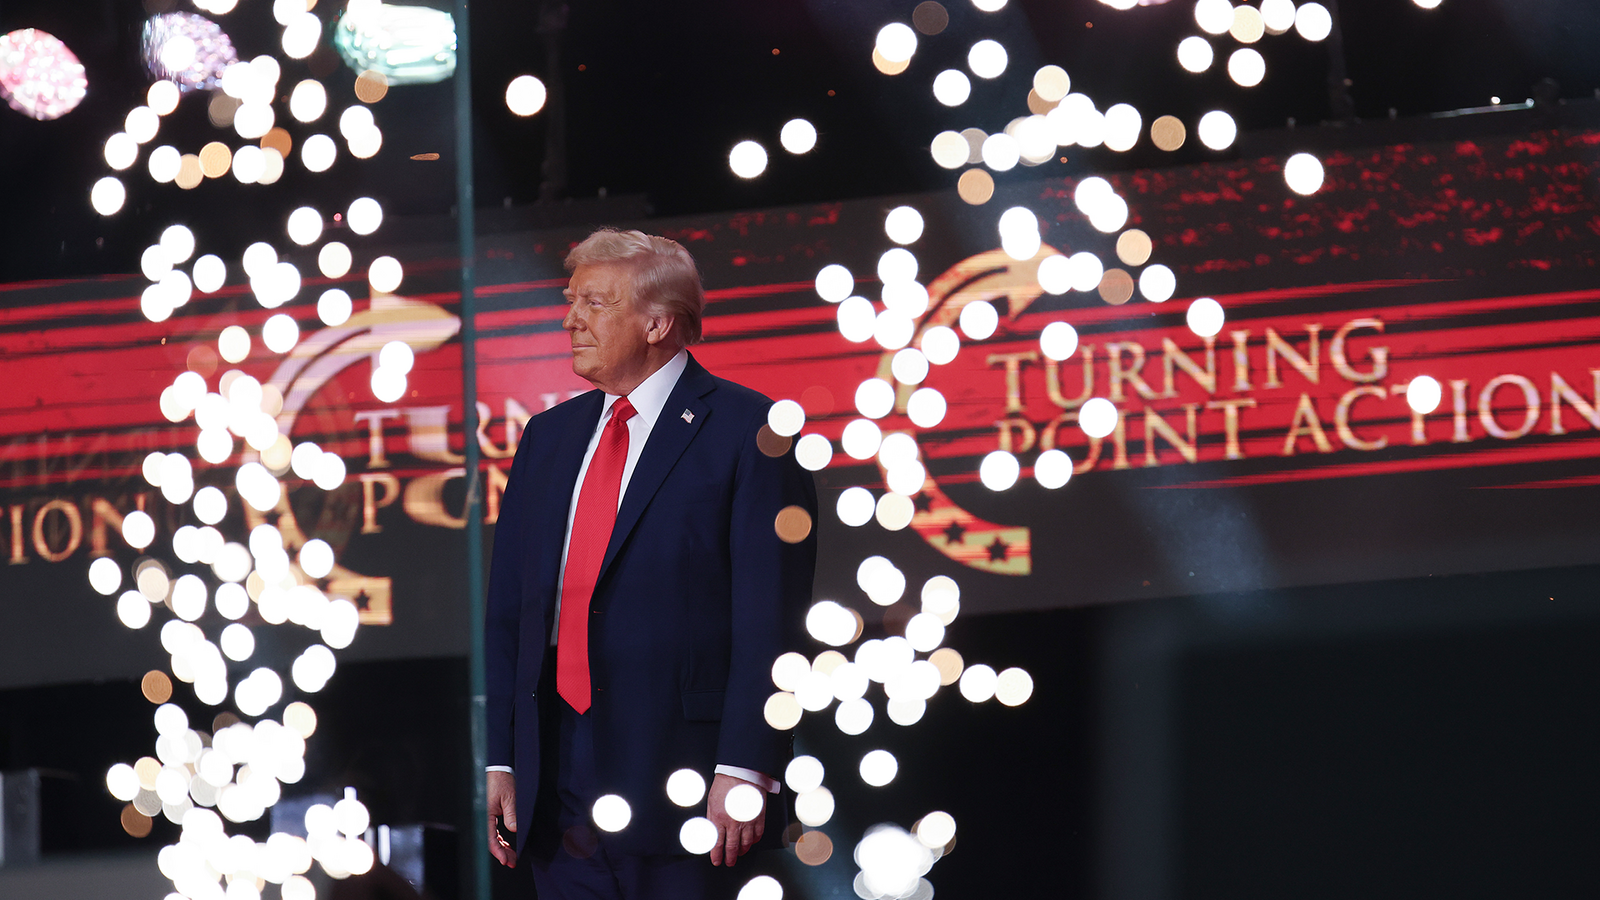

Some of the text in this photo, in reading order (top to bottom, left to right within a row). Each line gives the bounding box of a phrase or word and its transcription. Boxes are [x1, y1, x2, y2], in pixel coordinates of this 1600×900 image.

[987, 318, 1389, 413] TURNING
[354, 392, 559, 470] TURN
[994, 367, 1600, 475] POINT ACTION
[0, 493, 147, 565] ION
